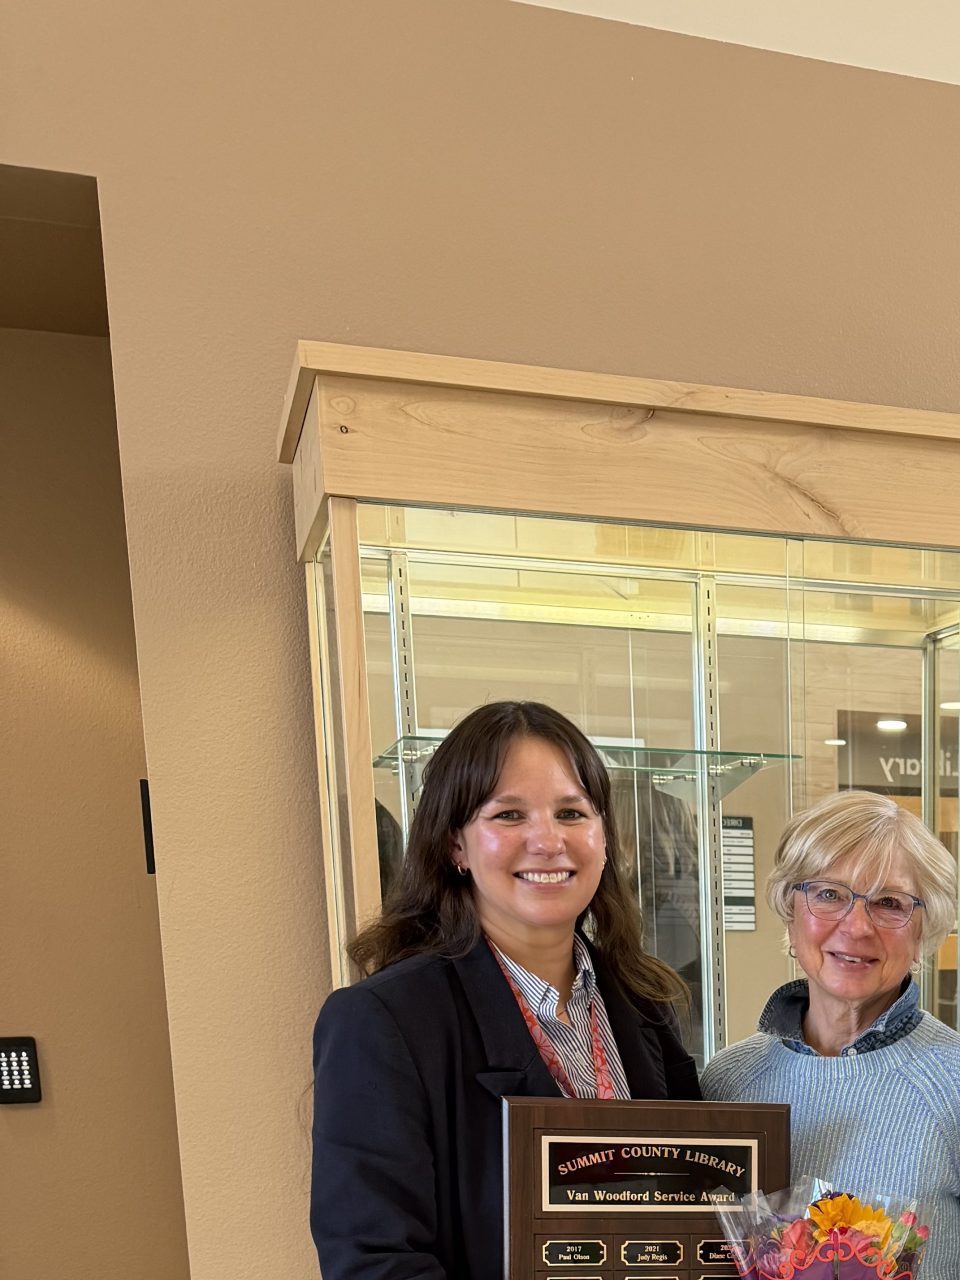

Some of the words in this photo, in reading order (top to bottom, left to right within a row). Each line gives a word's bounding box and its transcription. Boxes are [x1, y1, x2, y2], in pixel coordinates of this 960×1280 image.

[557, 1149, 615, 1176] SUMMIT
[621, 1146, 681, 1159] COUNTY
[685, 1150, 746, 1178] LIBRARY
[567, 1190, 589, 1201] Van
[594, 1190, 650, 1201] Woodford
[654, 1191, 696, 1202] Service
[700, 1192, 735, 1202] Award
[637, 1254, 650, 1262] Judy
